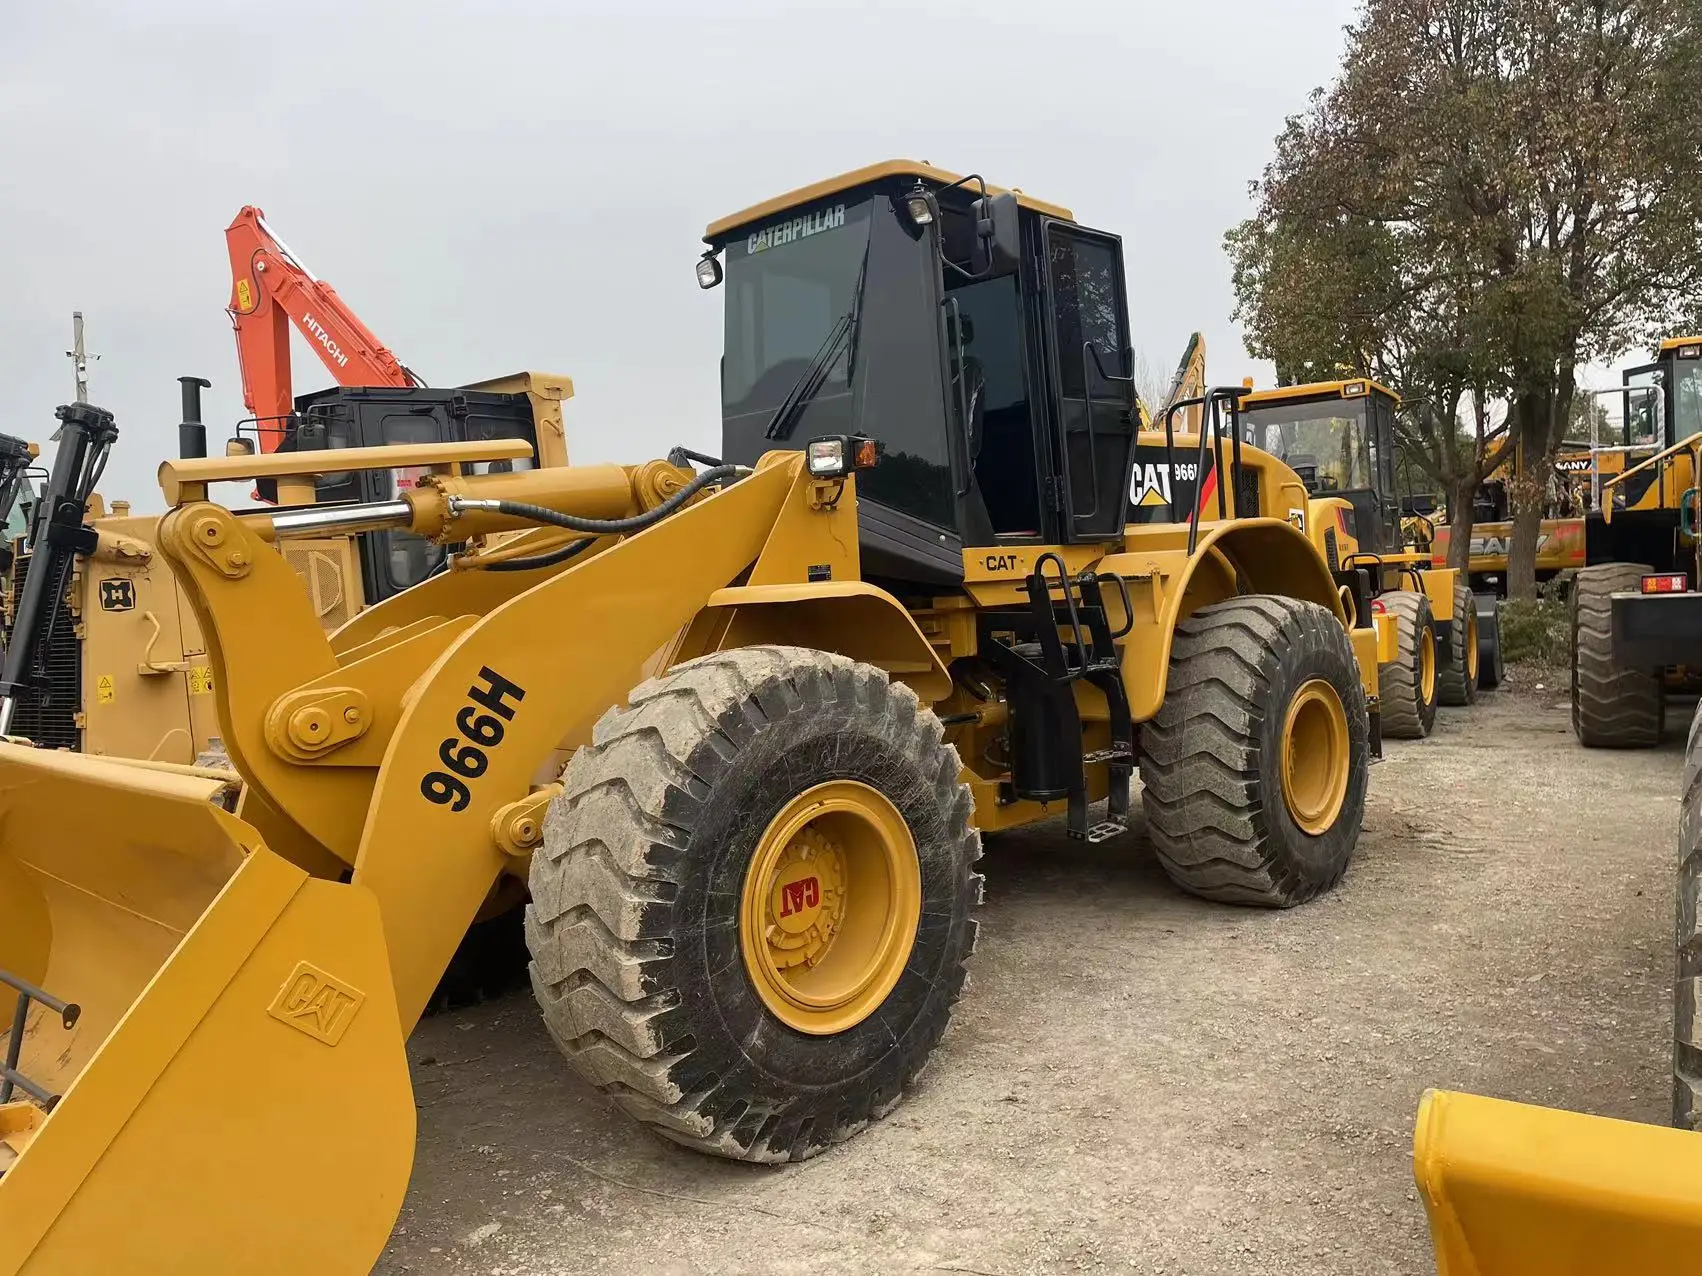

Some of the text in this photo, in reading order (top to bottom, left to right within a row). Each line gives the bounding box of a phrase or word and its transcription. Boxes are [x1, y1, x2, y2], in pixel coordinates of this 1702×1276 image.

[747, 204, 845, 255] CATERPILLAR
[303, 312, 349, 368] HITACHI
[1130, 463, 1172, 506] CAT
[986, 555, 1017, 571] CAT
[420, 665, 527, 813] 966H
[780, 876, 819, 918] CAT
[280, 972, 356, 1035] CAT
